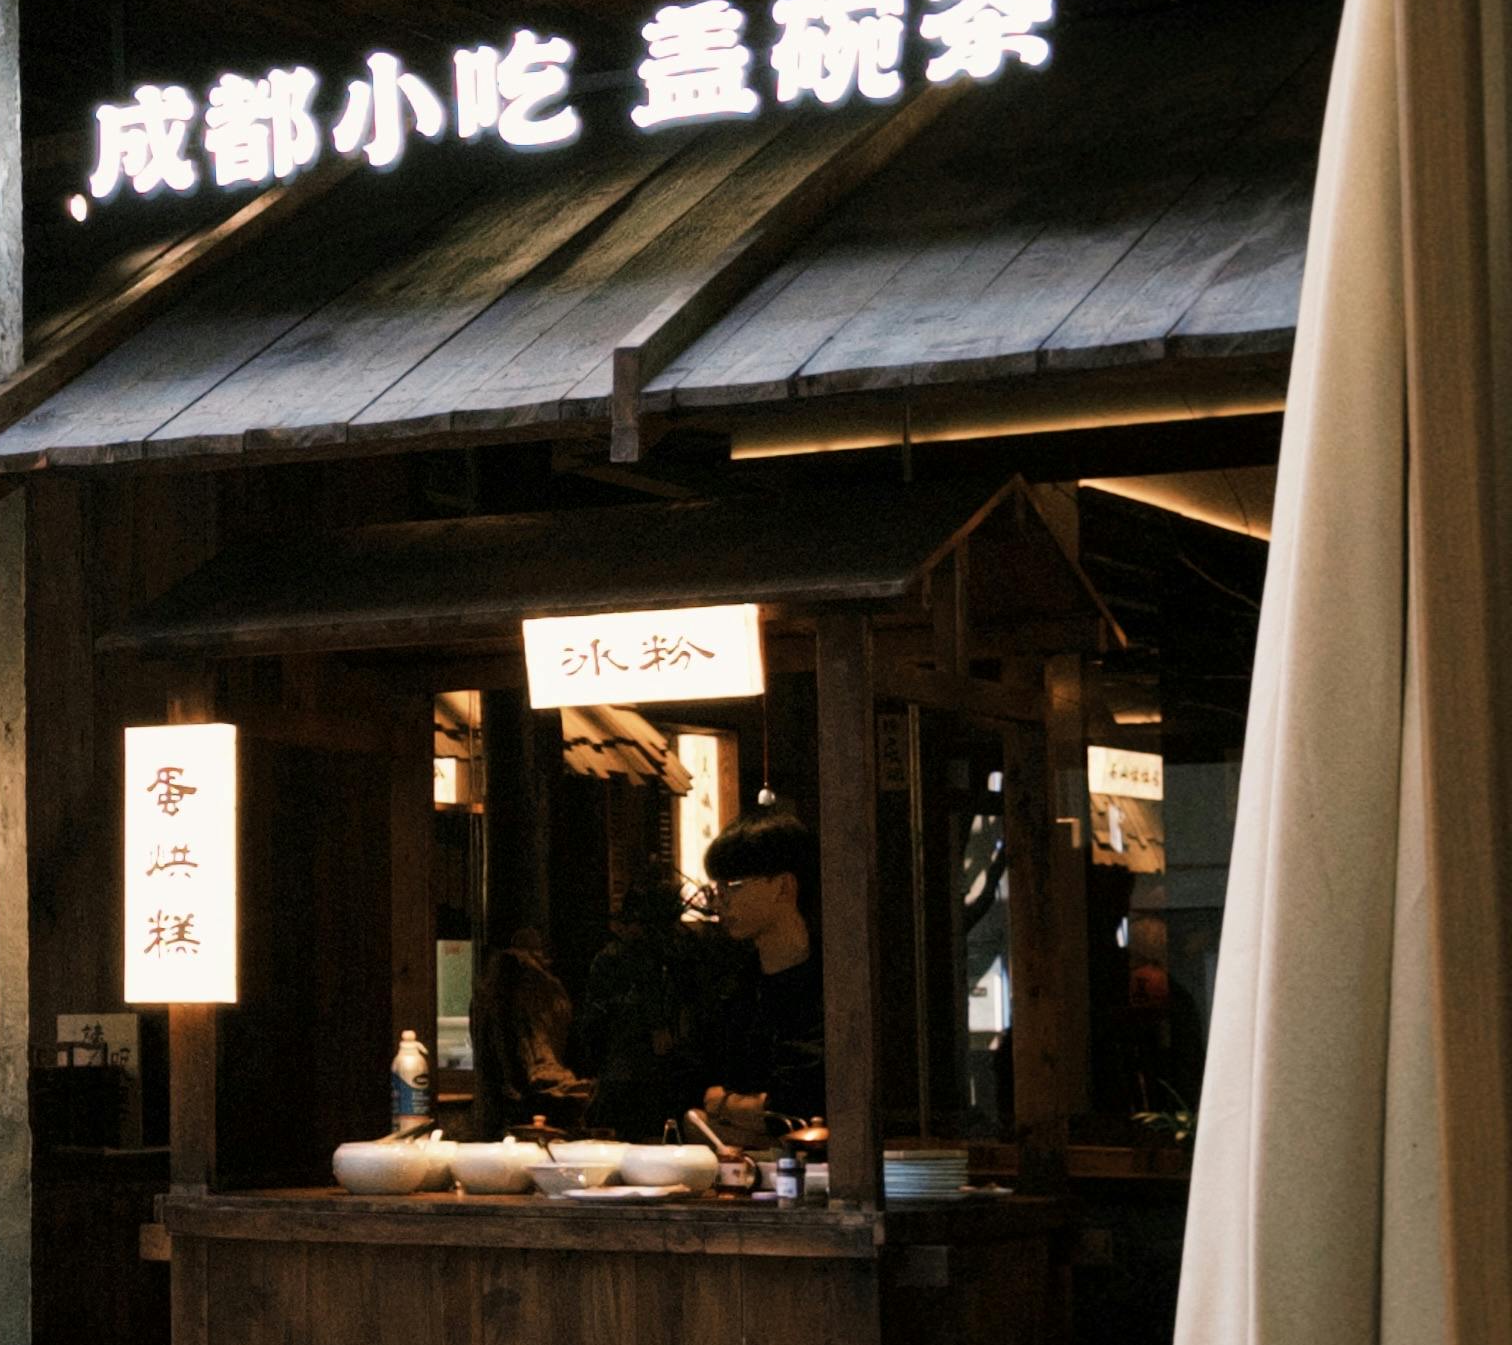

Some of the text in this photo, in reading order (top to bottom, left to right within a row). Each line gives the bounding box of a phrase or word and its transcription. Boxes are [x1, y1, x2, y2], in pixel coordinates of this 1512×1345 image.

[90, 29, 581, 198] 成都小吃
[561, 635, 716, 677] 冰粉
[143, 766, 201, 958] 蛋烘糕
